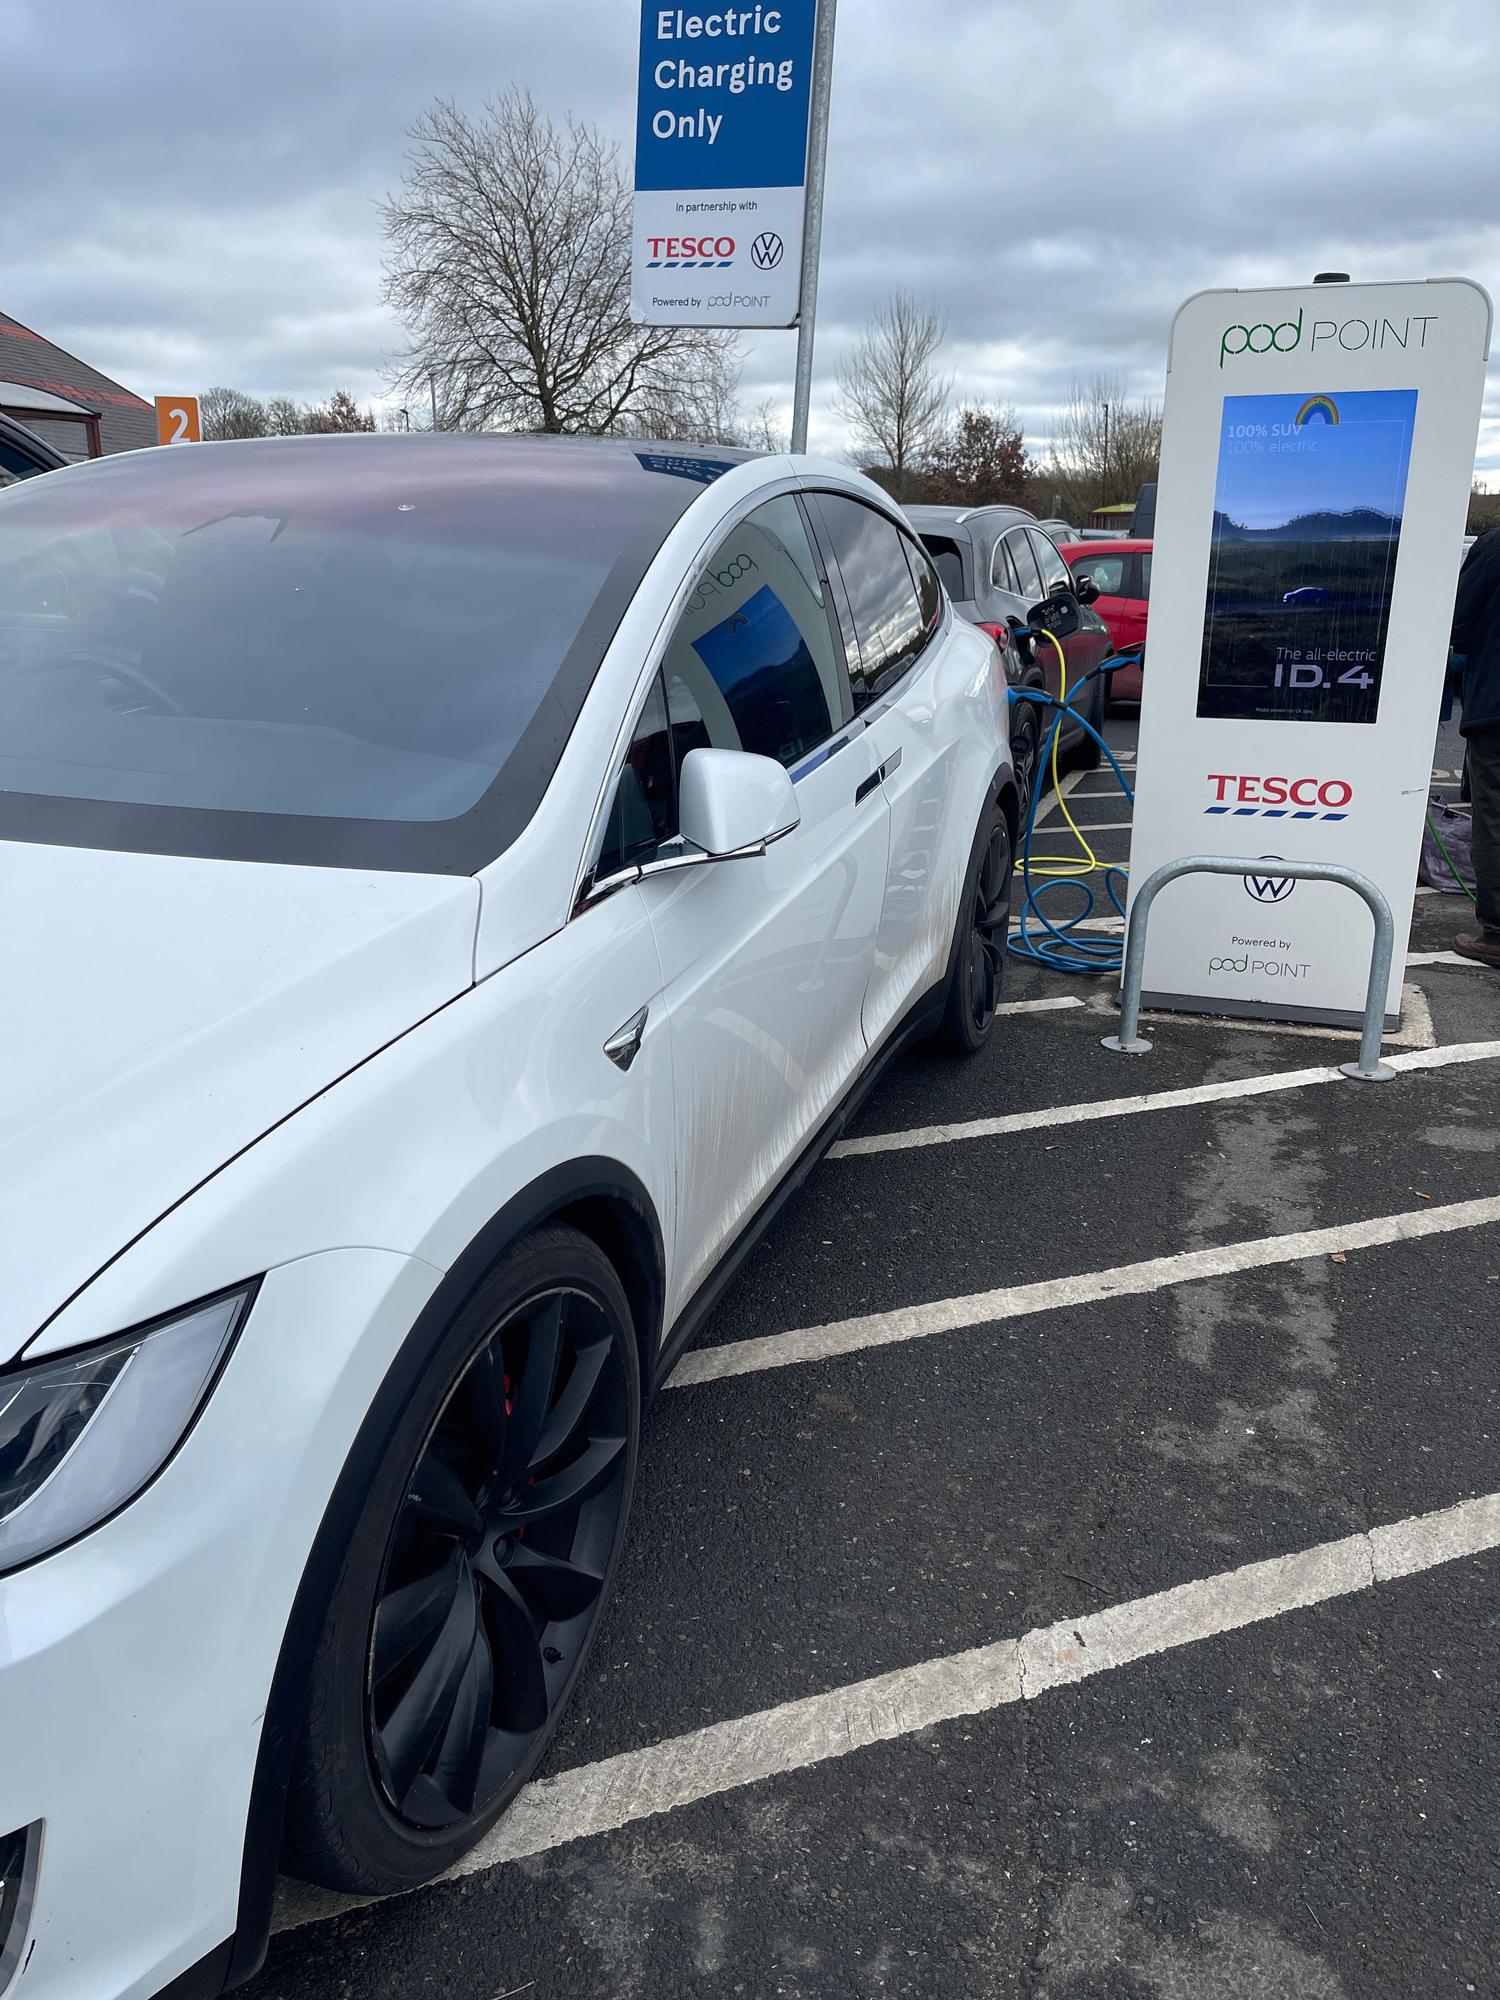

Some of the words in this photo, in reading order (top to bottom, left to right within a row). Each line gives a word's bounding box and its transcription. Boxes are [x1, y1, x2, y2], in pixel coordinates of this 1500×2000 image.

[657, 4, 782, 40] Electric
[654, 56, 794, 94] Charging
[652, 108, 723, 145] Only
[675, 202, 684, 212] In
[685, 201, 737, 214] partnership
[739, 200, 758, 211] with
[646, 236, 736, 258] TESCO
[652, 297, 689, 307] Powered
[691, 297, 701, 309] by
[707, 291, 733, 311] pod
[734, 295, 771, 308] POINT
[1219, 306, 1304, 370] pod
[1311, 316, 1439, 352] POINT
[169, 408, 190, 444] 2
[1227, 424, 1268, 438] 100%
[1271, 423, 1302, 437] SUV
[1226, 440, 1265, 454] 100%
[1268, 440, 1319, 453] electric
[1276, 646, 1302, 661] The
[1305, 647, 1377, 662] all-electric
[1273, 663, 1374, 690] ID.4
[1207, 774, 1353, 808] TESCO
[1231, 936, 1276, 948] Powered
[1279, 939, 1292, 951] by
[1208, 953, 1249, 976] pod
[1251, 960, 1312, 979] POINT
